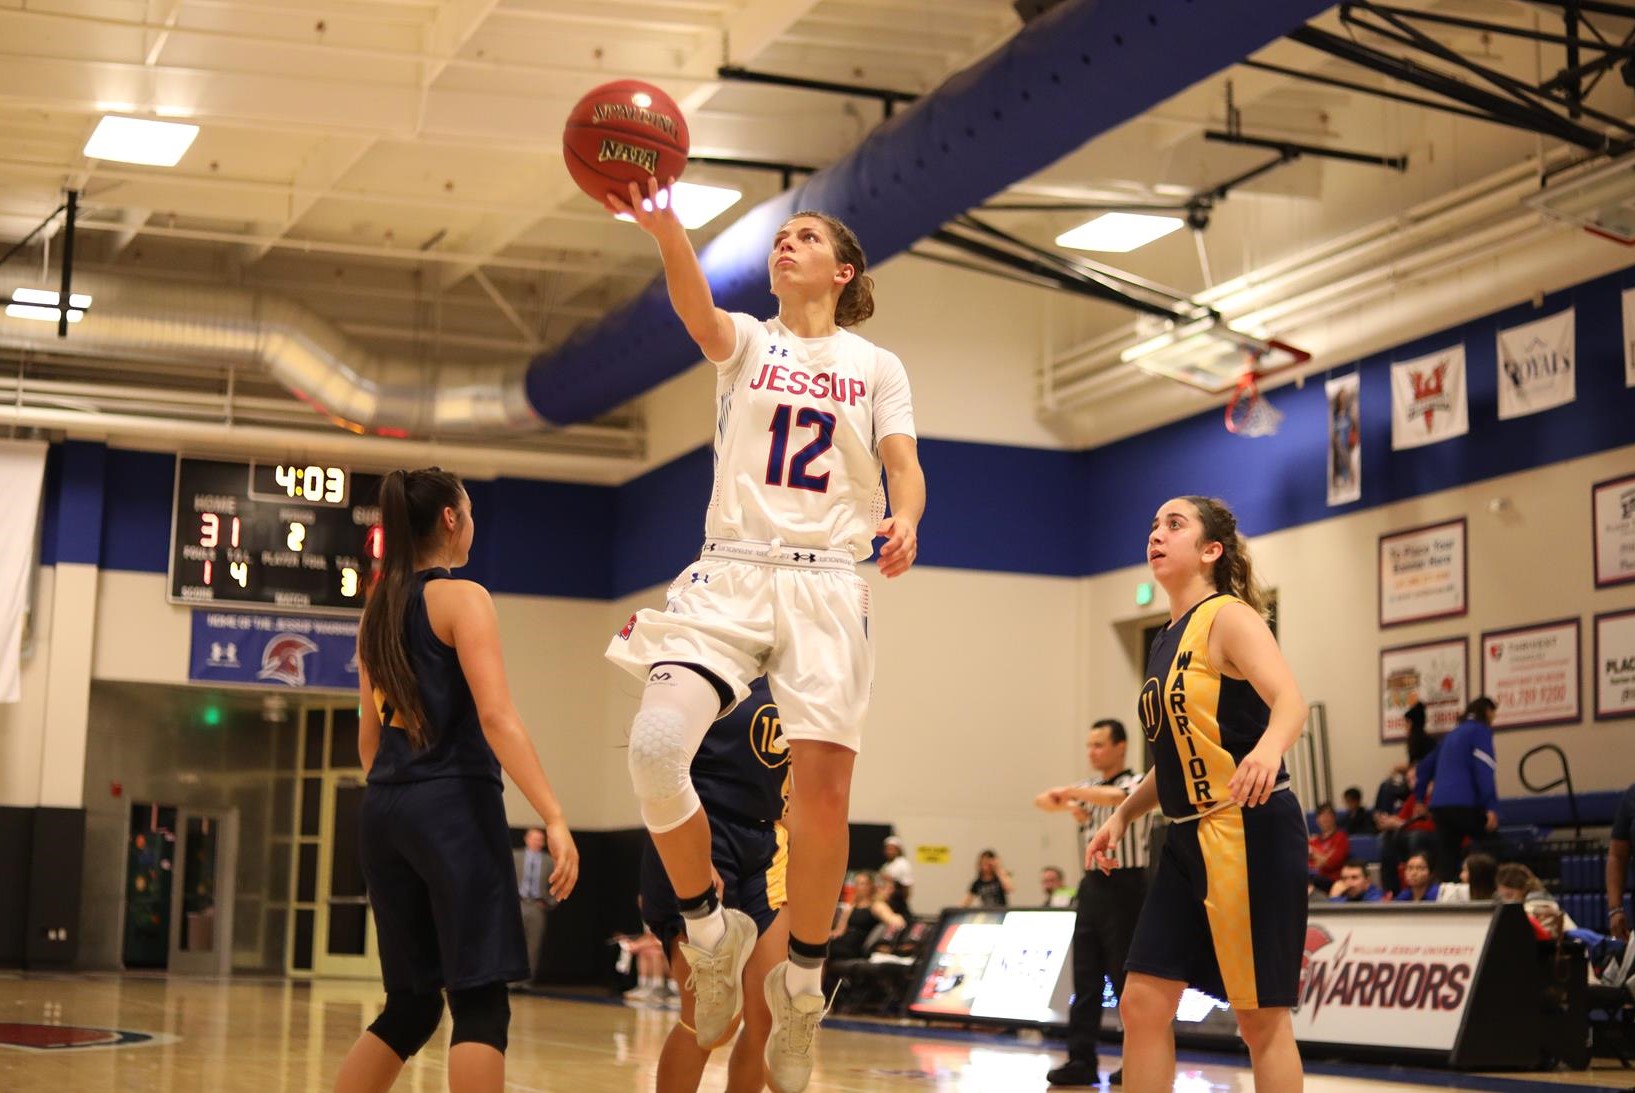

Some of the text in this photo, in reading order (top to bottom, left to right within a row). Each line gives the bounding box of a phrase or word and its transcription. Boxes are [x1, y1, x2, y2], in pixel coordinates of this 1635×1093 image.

[599, 140, 657, 175] NAIA
[750, 364, 866, 406] JESSUP
[765, 404, 837, 493] 12
[275, 465, 345, 503] 4:03
[199, 512, 240, 548] 31
[286, 522, 306, 551] 2
[203, 559, 212, 585] 1
[230, 561, 248, 588] 4
[341, 567, 358, 597] 3
[1304, 961, 1471, 1026] WARRIORS
